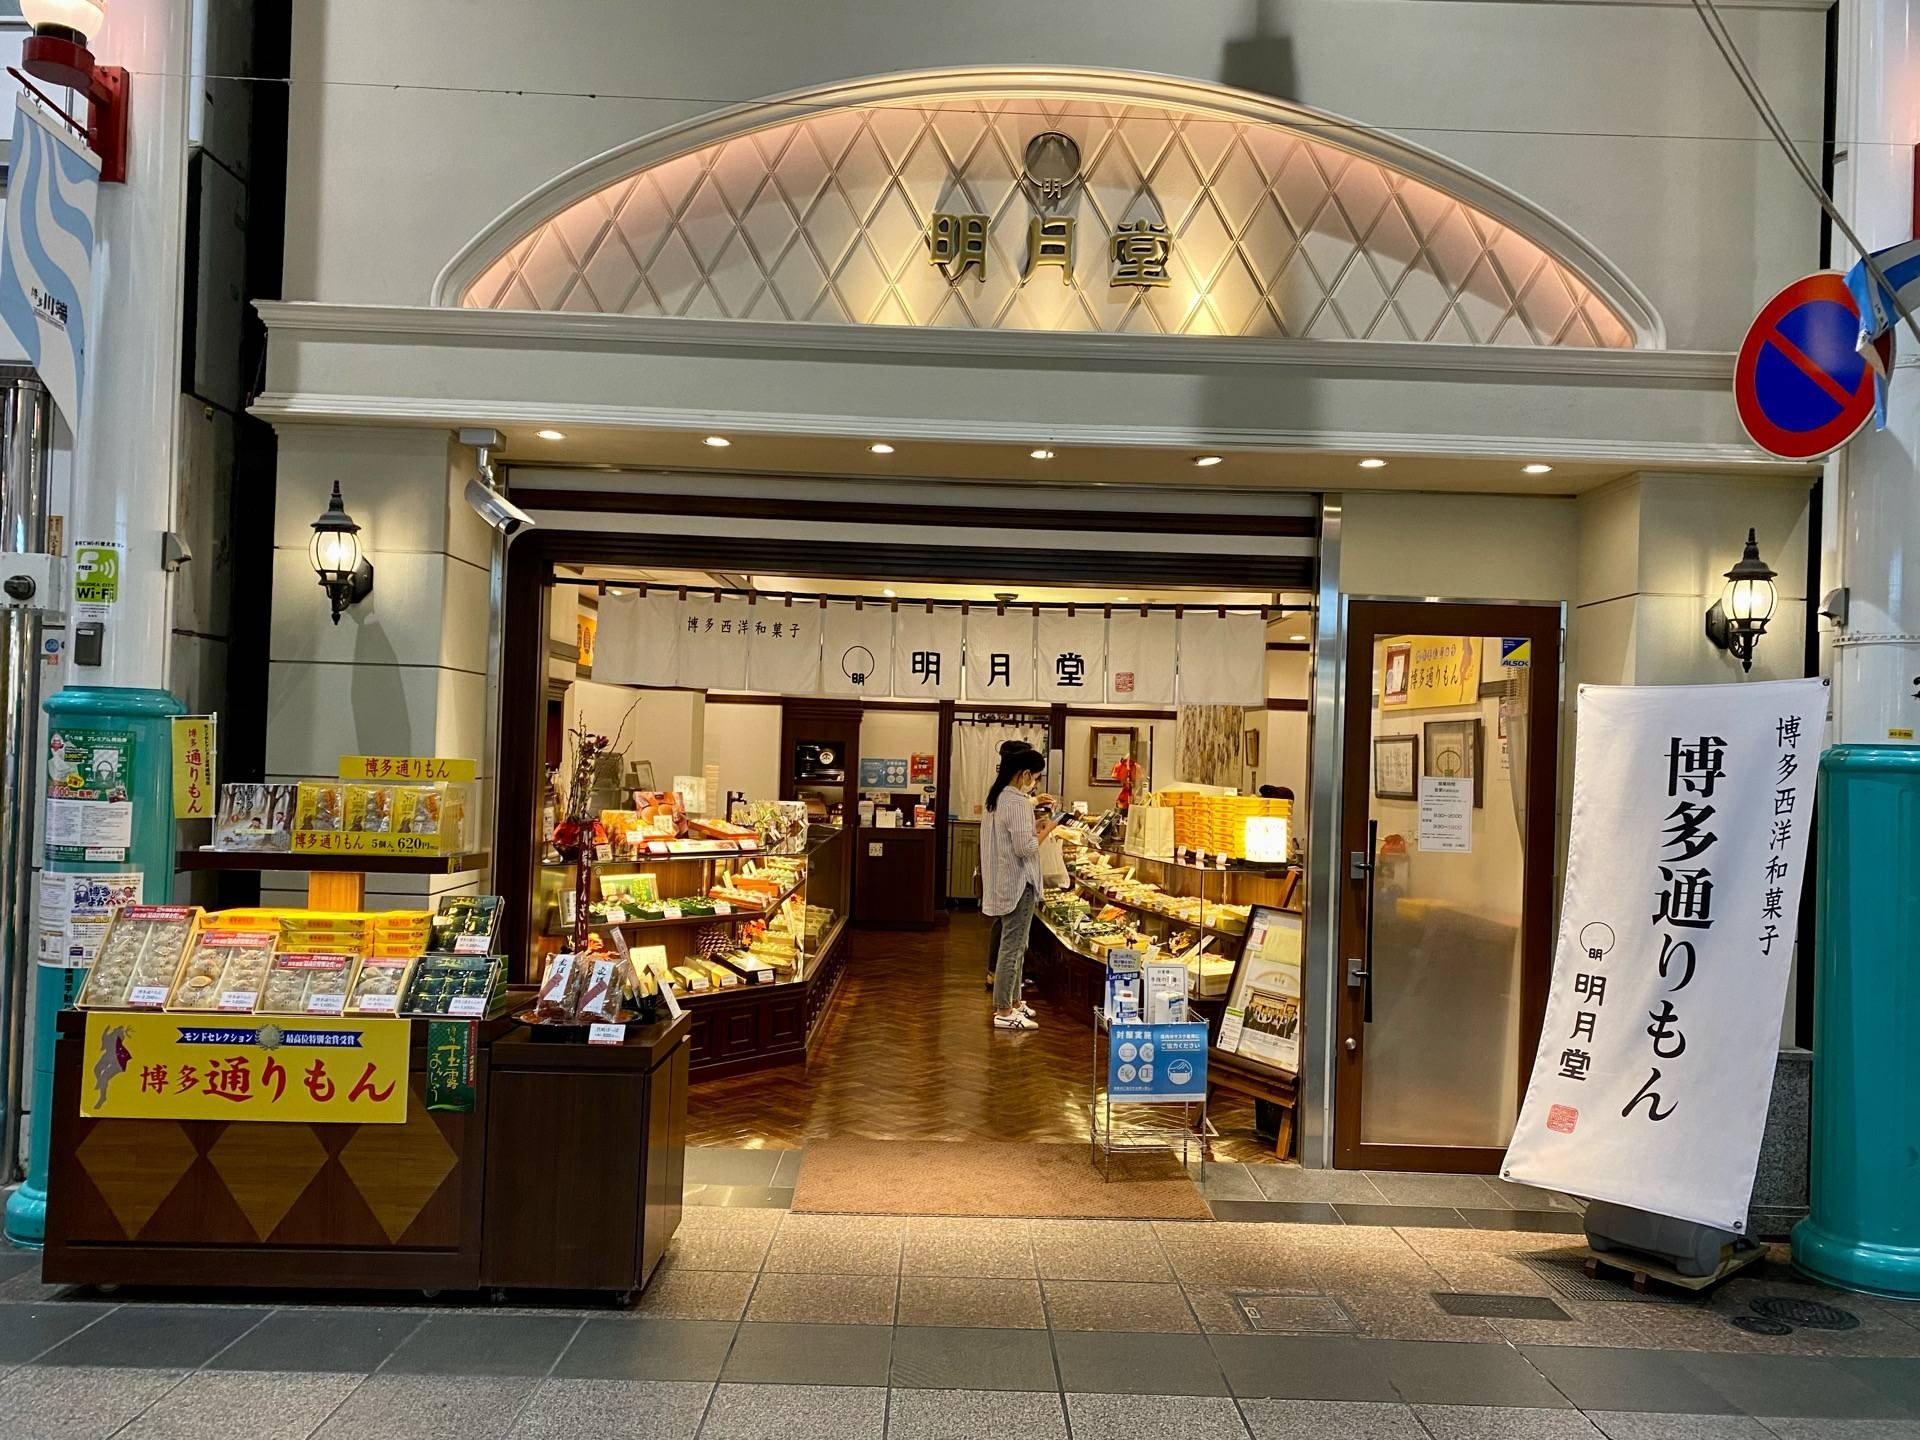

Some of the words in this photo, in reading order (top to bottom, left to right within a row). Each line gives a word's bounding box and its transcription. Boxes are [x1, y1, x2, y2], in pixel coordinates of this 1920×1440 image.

[1042, 178, 1062, 198] 明
[928, 213, 1174, 288] 明月堂
[77, 587, 114, 600] Wi-Fi
[687, 616, 801, 638] 博多西洋和菓子
[912, 651, 1085, 688] 明月堂
[185, 728, 203, 814] 博多通りもん
[365, 757, 450, 779] 博多通りもん
[295, 832, 365, 850] 博多通りもん
[1758, 715, 1801, 957] 博多西洋和菓子
[1621, 736, 1729, 1123] 博多通りもん
[184, 1031, 253, 1043] モンドセレクション
[1557, 972, 1608, 1083] 明月堂
[140, 1054, 397, 1104] 博多通りもん
